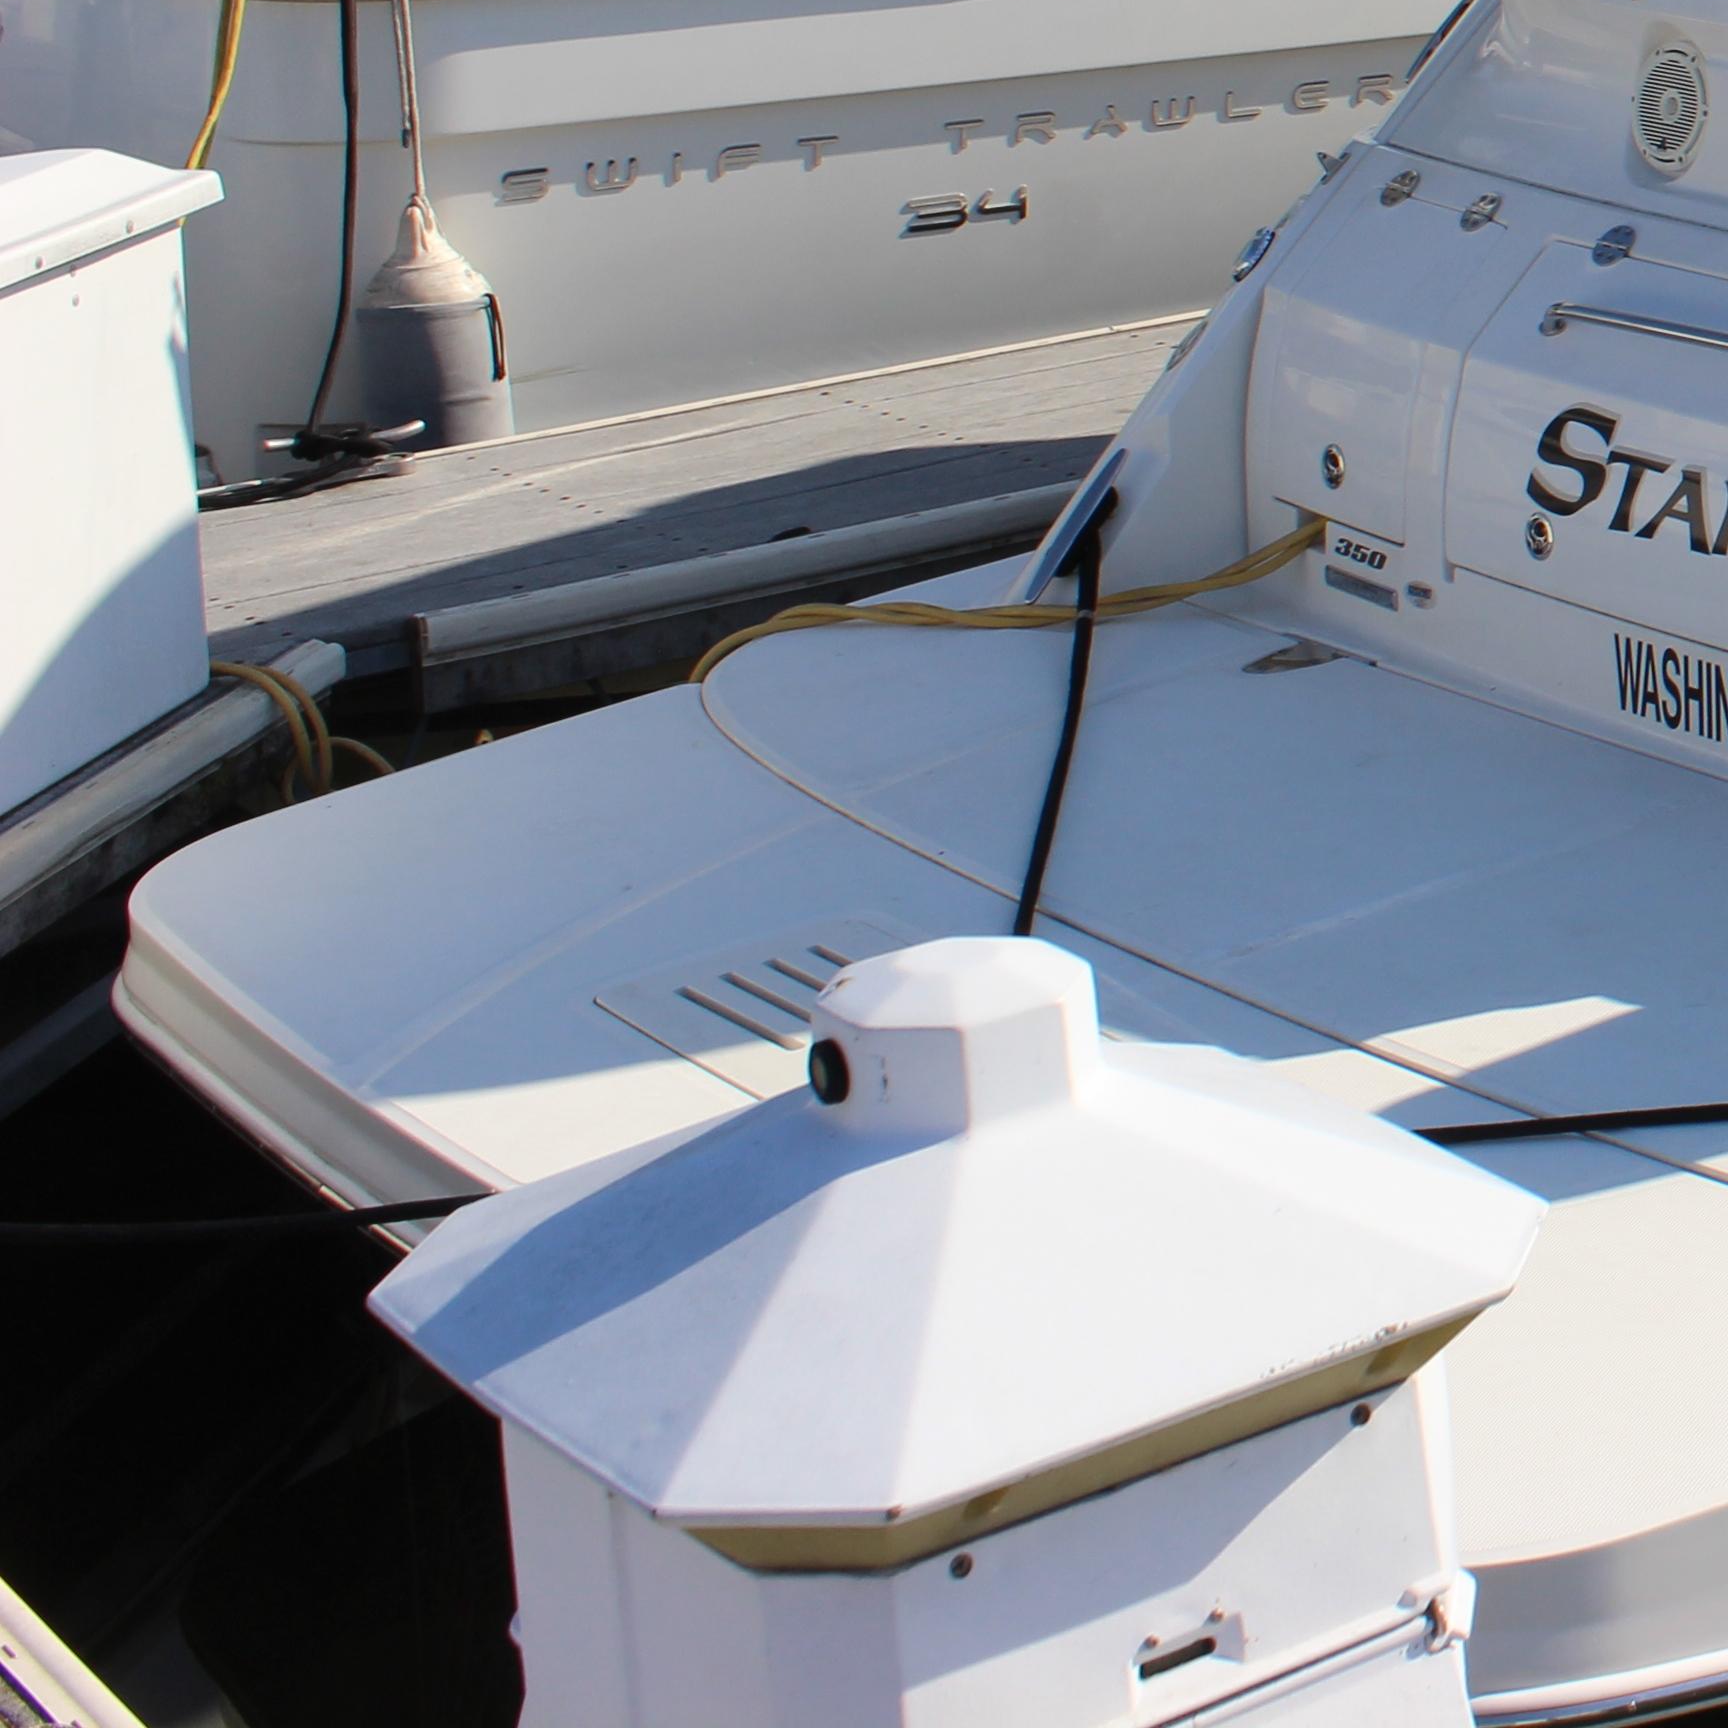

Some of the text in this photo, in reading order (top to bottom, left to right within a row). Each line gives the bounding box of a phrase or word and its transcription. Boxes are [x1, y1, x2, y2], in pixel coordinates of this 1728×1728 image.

[499, 73, 1395, 205] SWIFT TRAWLER
[901, 184, 1029, 235] 34
[1334, 537, 1388, 570] 350
